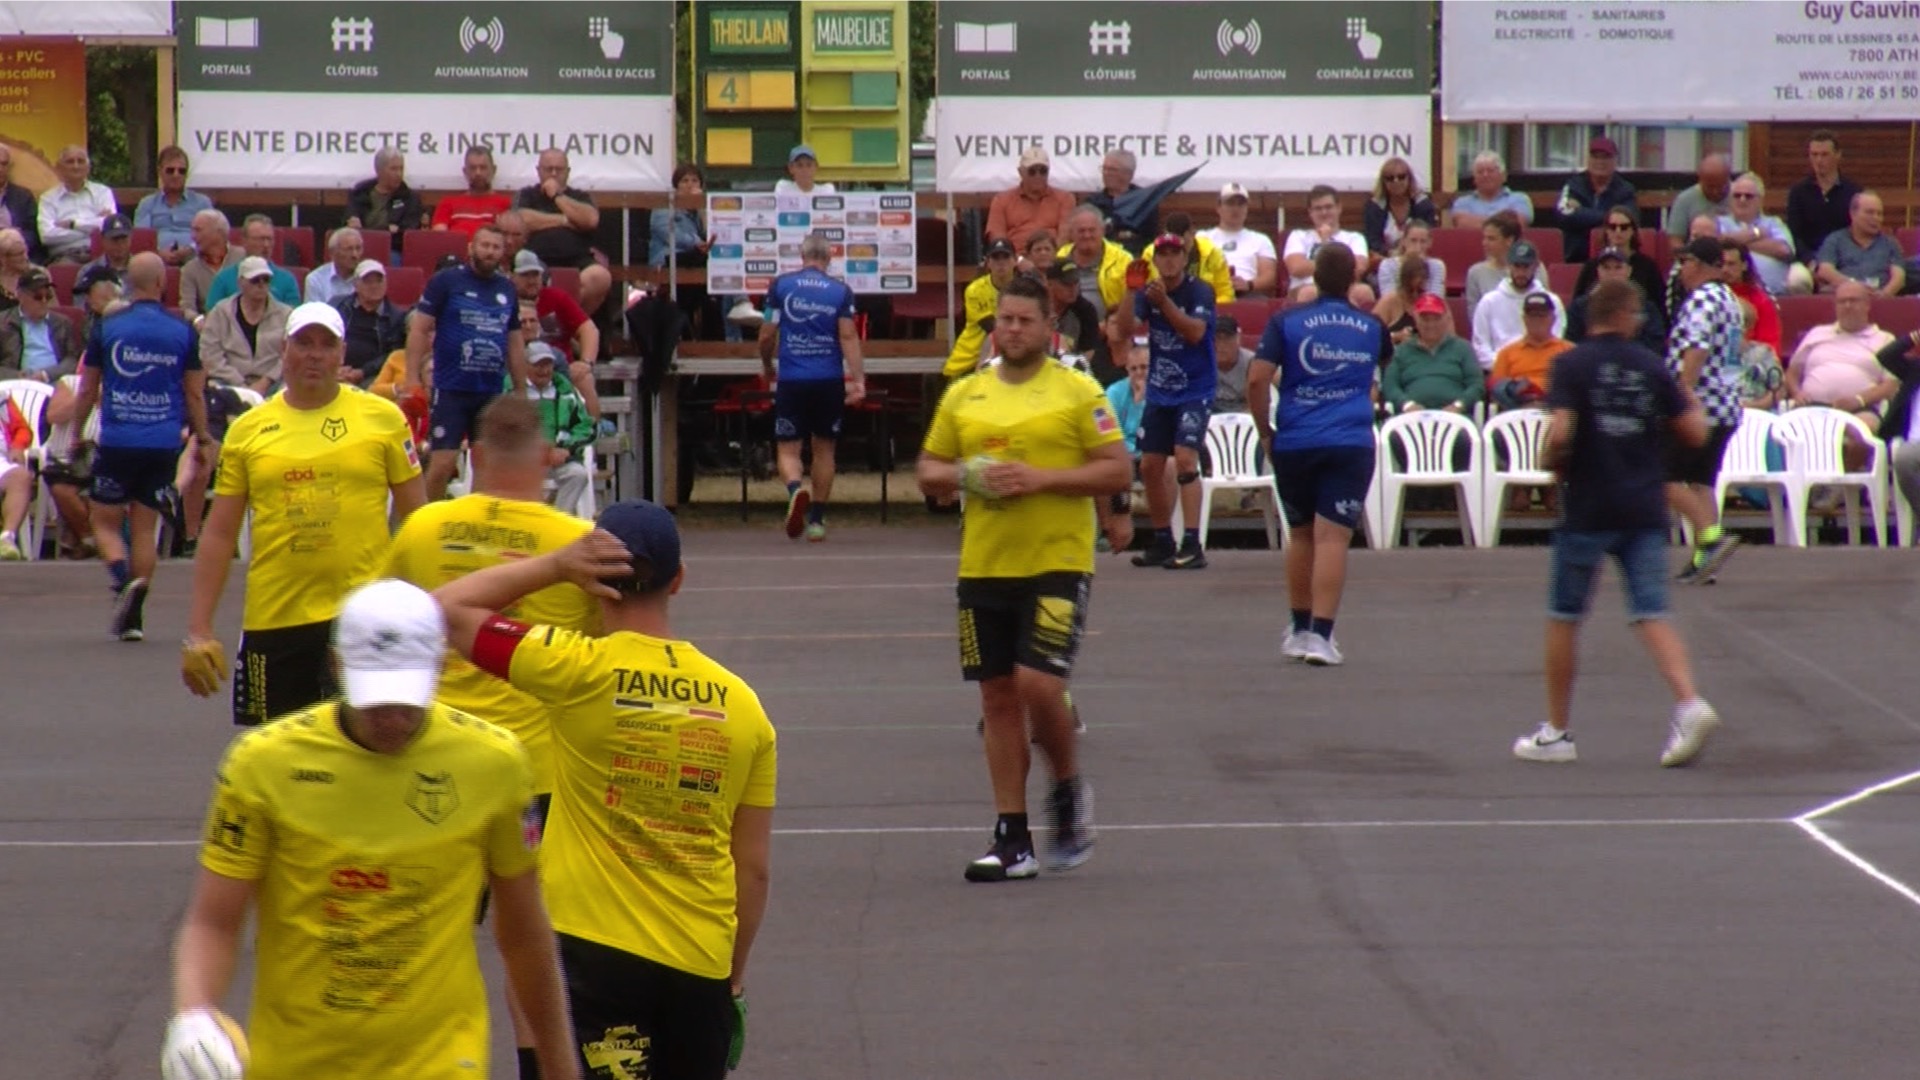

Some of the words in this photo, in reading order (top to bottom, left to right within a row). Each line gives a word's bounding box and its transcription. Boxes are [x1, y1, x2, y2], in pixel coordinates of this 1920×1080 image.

[1495, 9, 1567, 21] PLOMBERIE
[1591, 9, 1666, 21] SANITAIRES
[1804, 0, 1844, 24] Guy
[712, 18, 788, 46] THIEULAIN
[817, 17, 891, 46] MAUBEUGE
[1598, 28, 1675, 40] DOMOTIQUE
[1776, 33, 1815, 44] ROUTE
[1818, 33, 1834, 44] DE
[1838, 33, 1893, 44] LESSINES
[17, 50, 45, 62] PVC
[1848, 48, 1884, 62] 7800
[1888, 48, 1919, 62] ATH
[201, 64, 252, 76] PORTAILS
[325, 64, 379, 77] CLÔTURES
[434, 66, 529, 78] AUTOMATISATION
[558, 65, 613, 79] CONTRÔLE
[961, 69, 1011, 81] PORTAILS
[1083, 67, 1137, 81] CLÔTURES
[1192, 68, 1287, 80] AUTOMATISATION
[1316, 66, 1371, 80] CONTRÔLE
[1798, 70, 1918, 81] WWW.CAUVINGUY.BE
[719, 76, 739, 103] 4
[1817, 86, 1844, 99] 068
[1857, 86, 1875, 99] 26
[1880, 86, 1895, 99] 51
[1901, 86, 1919, 99] 50
[195, 130, 285, 153] VENTE
[295, 131, 409, 154] DIRECTE
[418, 132, 438, 154] &
[449, 132, 653, 155] INSTALLATION
[955, 134, 1044, 157] VENTE
[1054, 134, 1167, 157] DIRECTE
[1177, 134, 1197, 157] &
[1206, 134, 1412, 157] INSTALLATION
[1304, 313, 1368, 332] WILLIAM
[123, 350, 178, 366] Maubeuge
[613, 668, 728, 707] TANGUY
